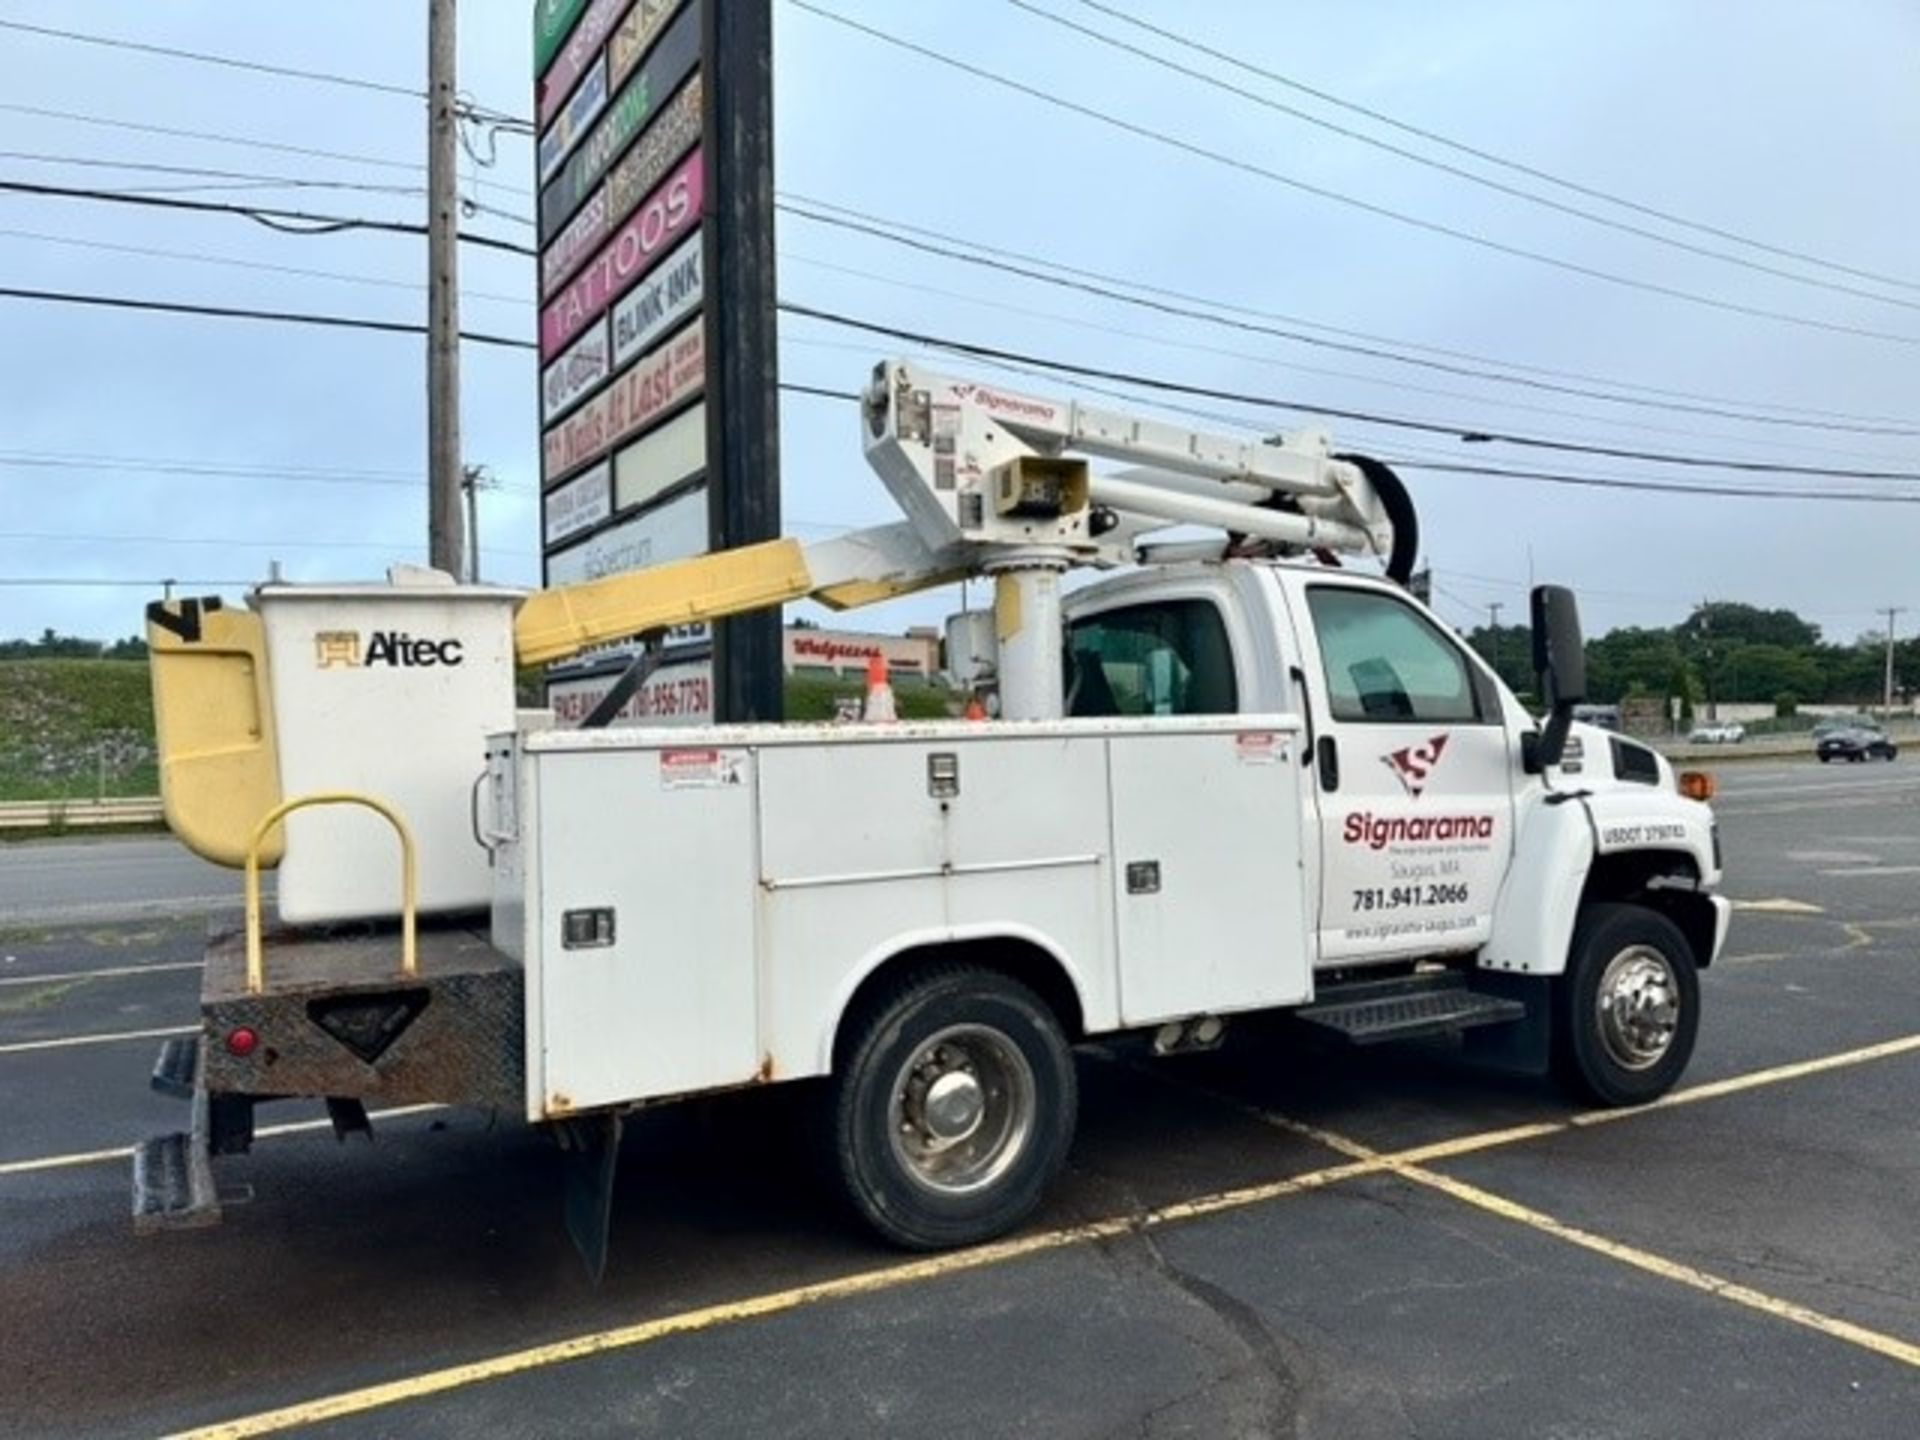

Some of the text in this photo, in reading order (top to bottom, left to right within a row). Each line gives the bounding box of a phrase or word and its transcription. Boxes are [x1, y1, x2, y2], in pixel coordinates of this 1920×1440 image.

[554, 174, 690, 338] TATTOOS
[617, 251, 701, 350] BLINK INK
[628, 349, 672, 423] Last
[974, 388, 1056, 421] Signarama
[363, 630, 464, 667] Altec
[793, 637, 881, 660] Walgreens
[1343, 811, 1494, 850] Signarama
[1352, 882, 1468, 911] 781.941.2066
